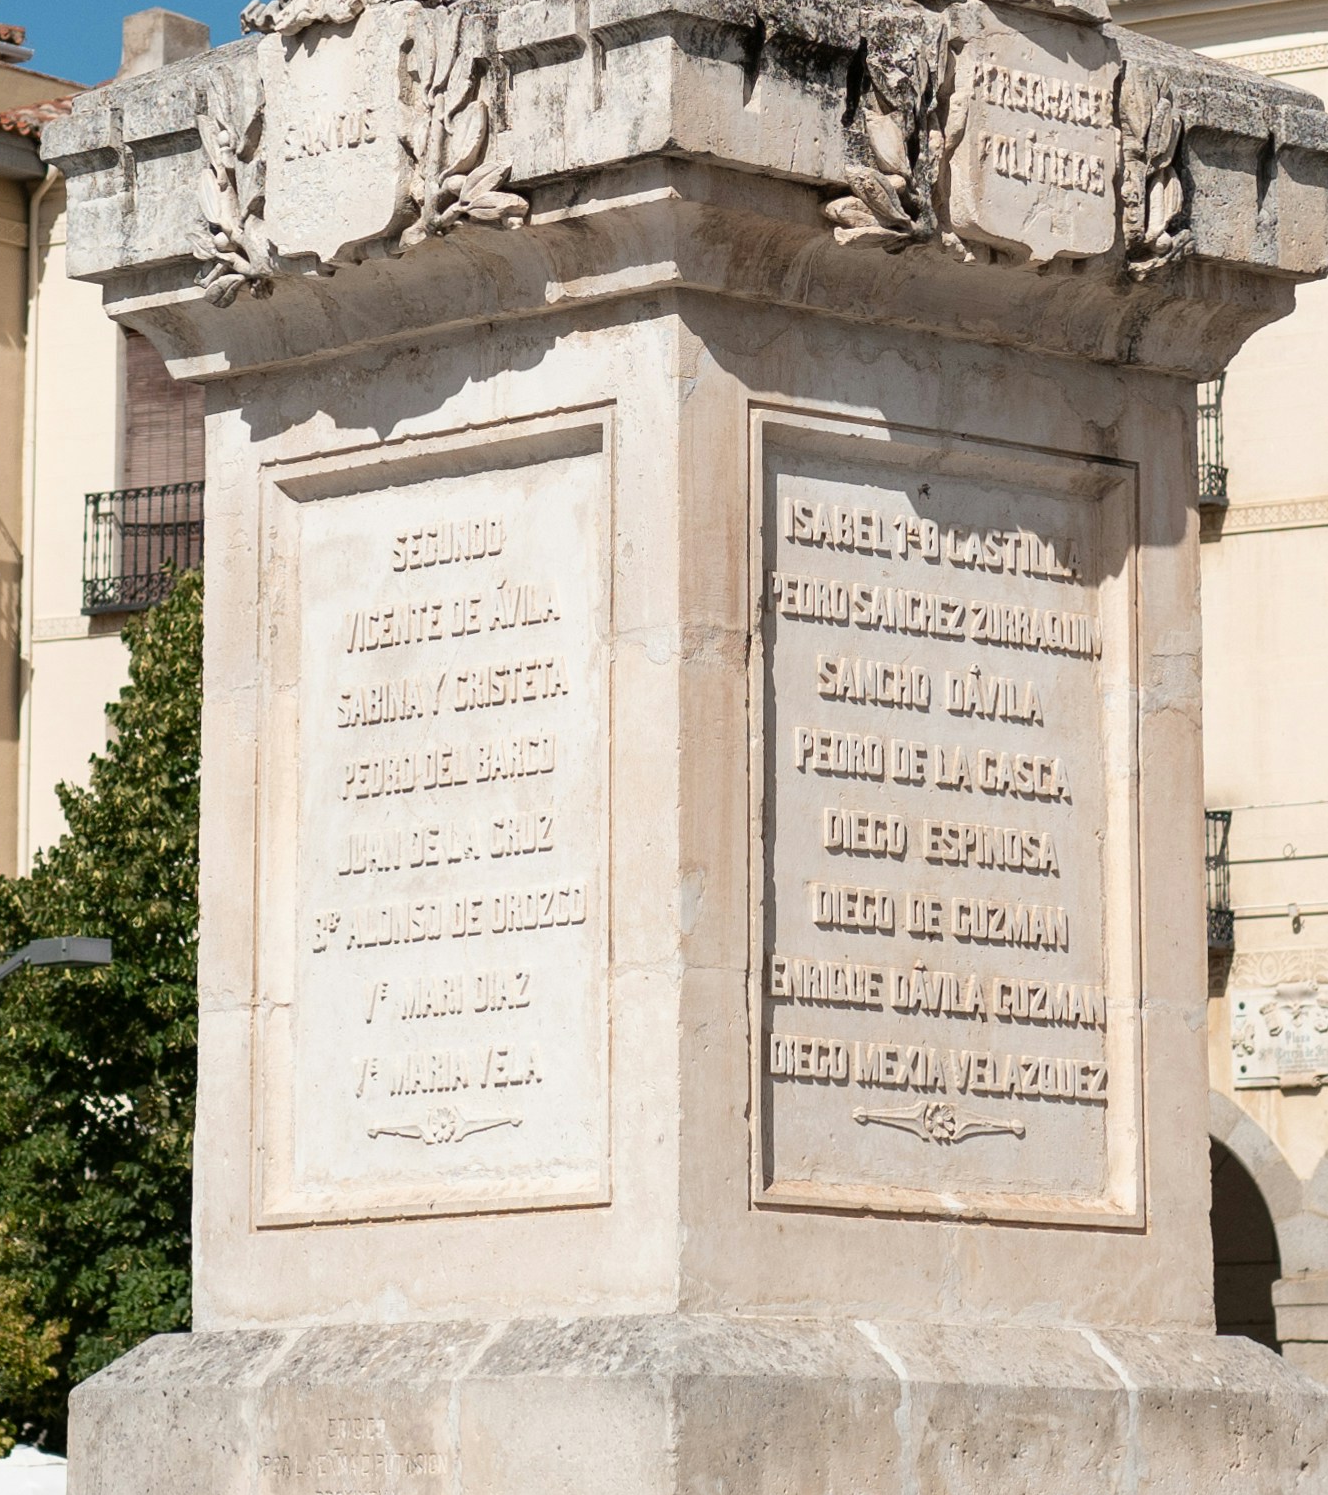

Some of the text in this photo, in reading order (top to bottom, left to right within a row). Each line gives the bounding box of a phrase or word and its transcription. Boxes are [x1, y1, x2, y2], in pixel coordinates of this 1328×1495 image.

[393, 516, 508, 572] SEGUNDO
[784, 497, 891, 557] ISABEL
[946, 526, 1084, 584] CASTILLA
[346, 579, 561, 653] VICENTE DE ÁVILA
[769, 571, 1103, 659] PEDRO SANCHEZ ZURRAQUIN
[337, 655, 569, 729] SABINA Y CRISTETA
[816, 653, 931, 712] SANCHO
[338, 731, 556, 802] PEDRO DEL BARCO
[794, 726, 1073, 804] PEDRO DE LA GASCA
[338, 808, 554, 876] JUAN DE LA CRUZ
[823, 807, 1061, 876] DIEGO ESPINOSA
[346, 896, 442, 950] ALONSO
[451, 892, 483, 939] DE
[491, 880, 588, 934] OROZCO
[811, 881, 1070, 951] DIEGO DE GUZMAN
[401, 974, 464, 1021] MARI
[473, 968, 531, 1013] DIAZ
[769, 954, 883, 1007] ENRIQUE
[992, 978, 1107, 1031] GUZMAN
[390, 1047, 470, 1097] MARIA
[479, 1041, 544, 1089] VELA
[769, 1034, 1108, 1104] DIEGO MEXIA VELAZQUEZ
